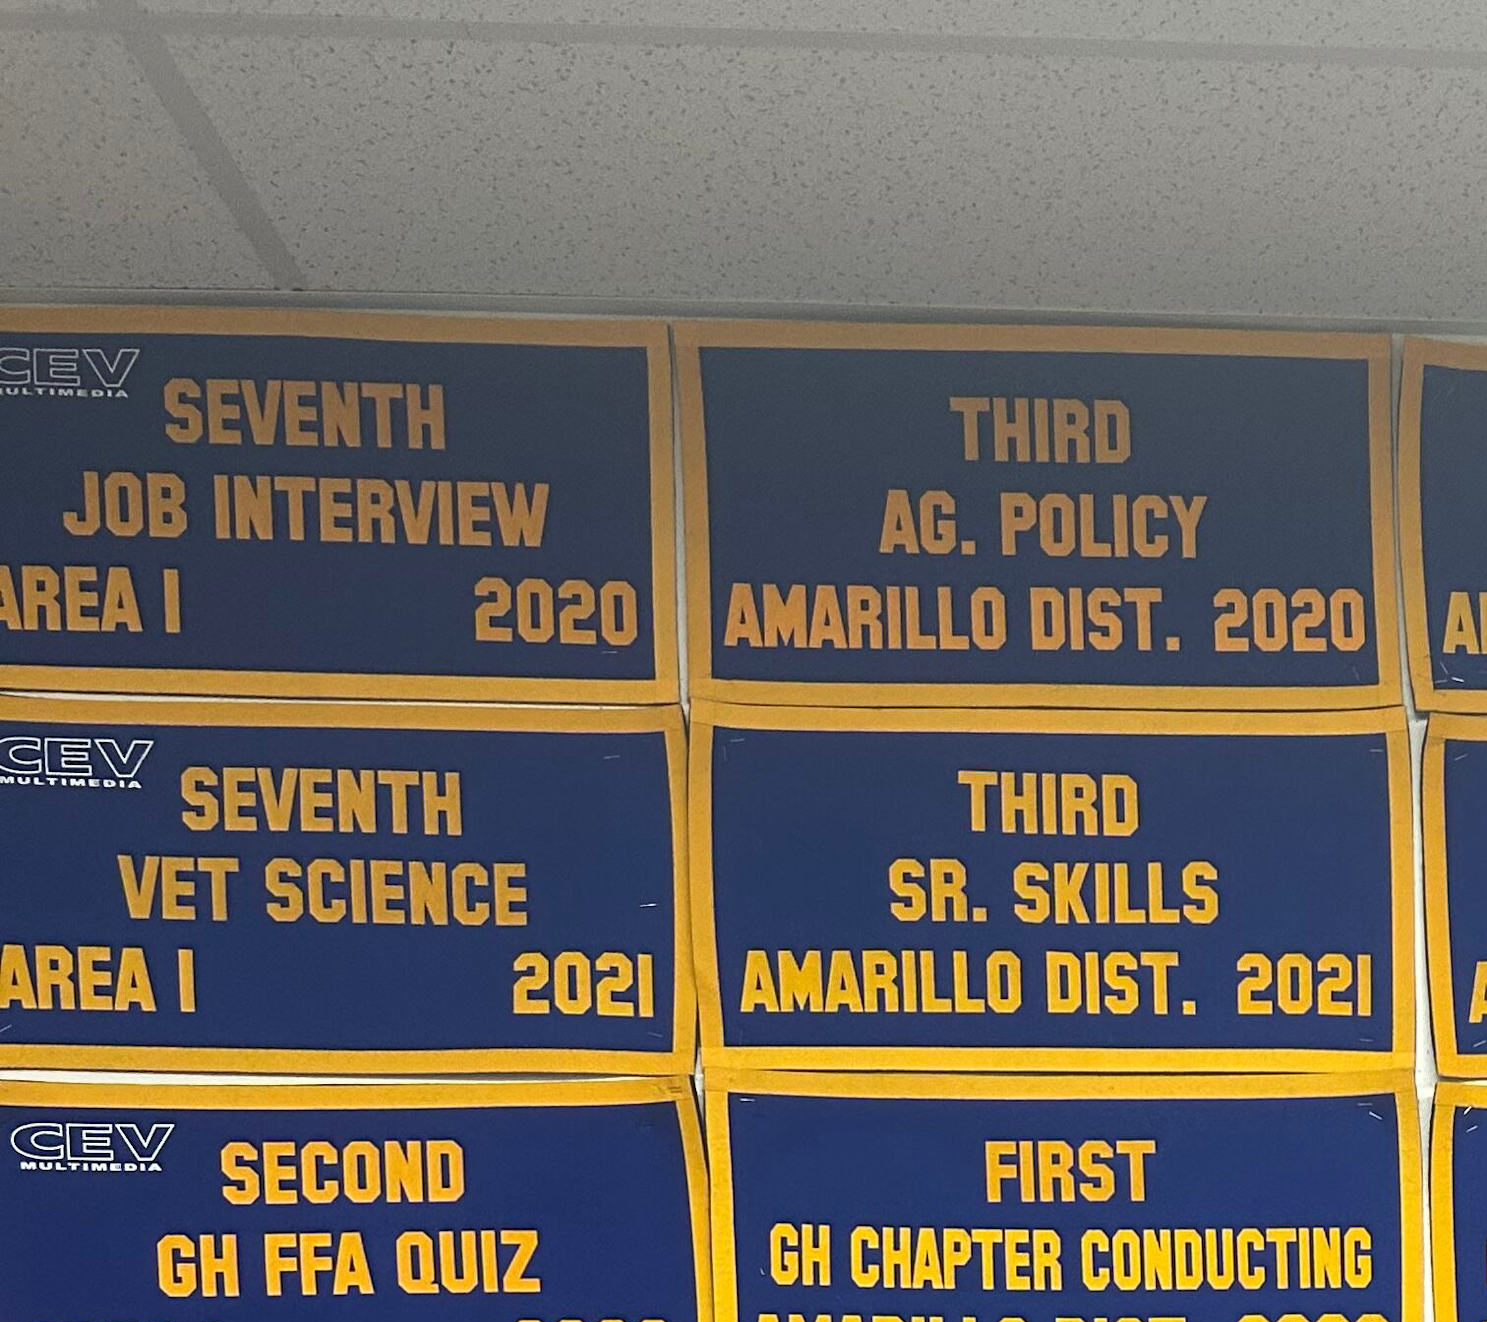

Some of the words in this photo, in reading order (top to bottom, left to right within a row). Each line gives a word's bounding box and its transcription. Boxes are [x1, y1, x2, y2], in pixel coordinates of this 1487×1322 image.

[164, 378, 444, 448] SEVENTH
[952, 398, 1129, 463] THIRD
[63, 472, 187, 538] JOB
[214, 476, 549, 547] INTERVIEW
[880, 490, 976, 555] AG.
[1001, 492, 1206, 558] POLICY
[163, 569, 180, 633] I
[474, 577, 637, 646] 2020
[724, 583, 1006, 650] AMARILLO
[1030, 587, 1180, 651] DIST.
[1214, 588, 1365, 652] 2020
[0, 737, 154, 777] CEV
[181, 767, 462, 835] SEVENTH
[958, 771, 1138, 836] THIRD
[118, 855, 239, 921] VET
[265, 858, 527, 925] SCIENCE
[889, 859, 987, 922] SR.
[1013, 861, 1218, 924] SKILLS
[178, 949, 195, 1012] I
[513, 952, 653, 1017] 2021
[740, 950, 1021, 1013] AMARILLO
[1046, 951, 1196, 1015] DIST.
[1237, 953, 1371, 1016] 2021
[9, 1122, 175, 1161] CEV
[19, 1162, 164, 1173] MULTIMEDIA
[221, 1140, 464, 1205] SECOND
[985, 1140, 1155, 1202] FIRST
[157, 1234, 239, 1297] GH
[264, 1232, 373, 1296] FFA
[396, 1230, 541, 1294] QUIZ
[770, 1223, 830, 1286] GH
[850, 1226, 1062, 1290] CHAPTER
[1081, 1227, 1372, 1291] CONDUCTING
